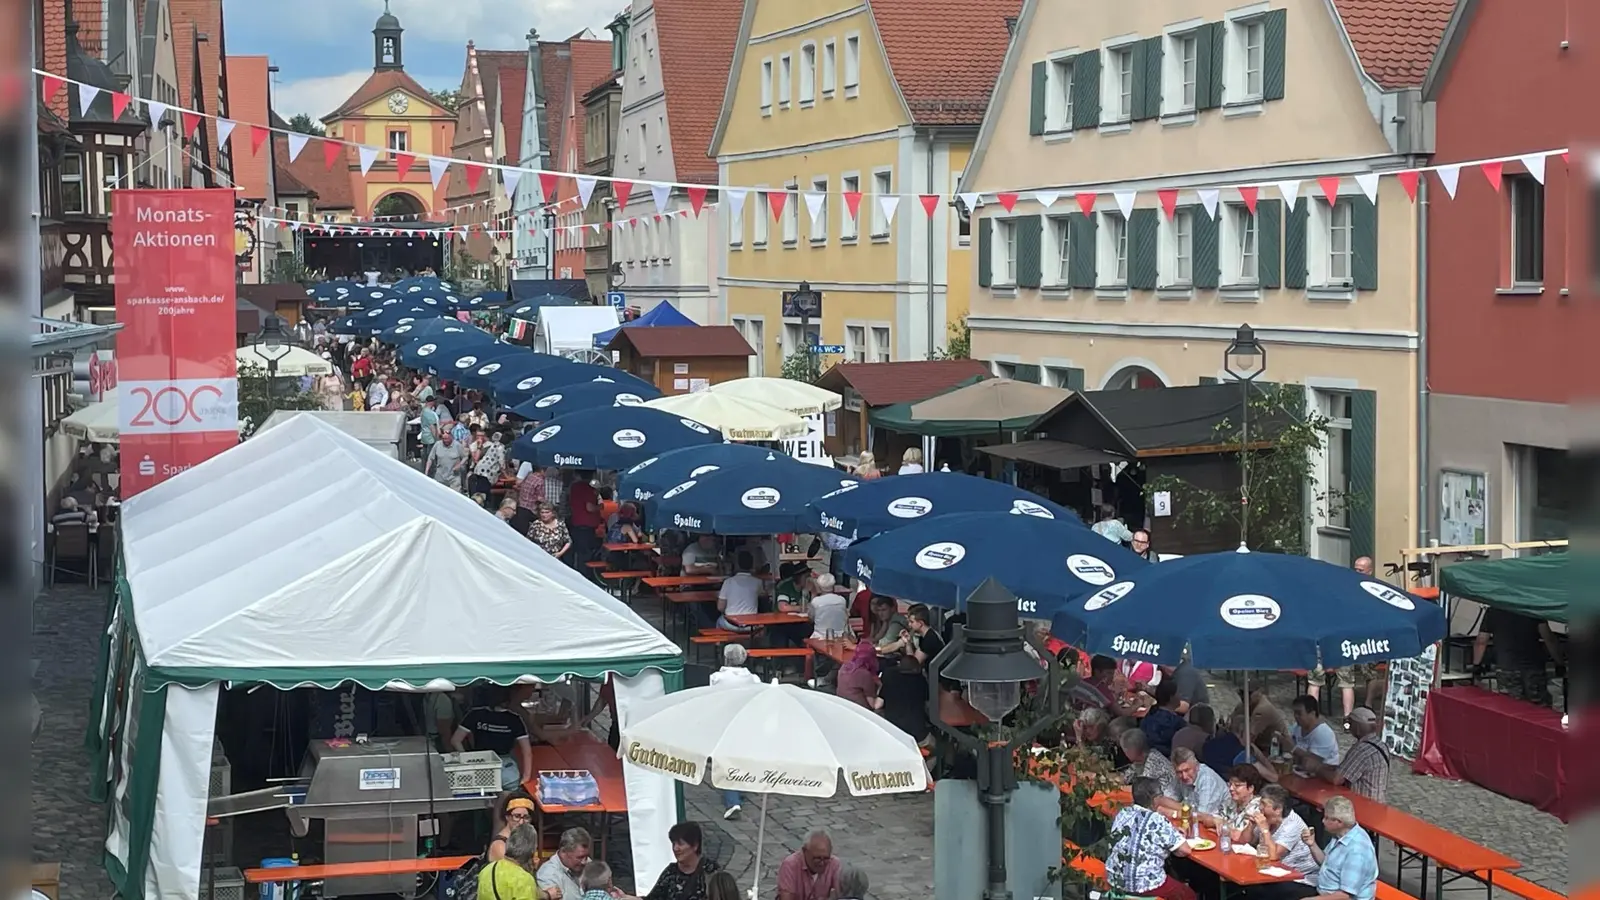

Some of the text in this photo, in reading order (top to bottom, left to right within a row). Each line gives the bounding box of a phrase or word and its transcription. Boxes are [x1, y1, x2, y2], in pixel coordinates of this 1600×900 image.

[136, 207, 213, 223] Monats-
[133, 231, 216, 248] Aktionen
[611, 294, 622, 306] P
[553, 453, 583, 467] Spalter
[1159, 501, 1166, 511] 9
[673, 513, 702, 529] Spalter
[1111, 634, 1161, 657] Spalter
[1341, 639, 1391, 660] Spalter
[629, 741, 697, 779] Gutmann
[725, 767, 823, 788] Gutes Hefeweizen
[851, 770, 915, 791] Gutmann
